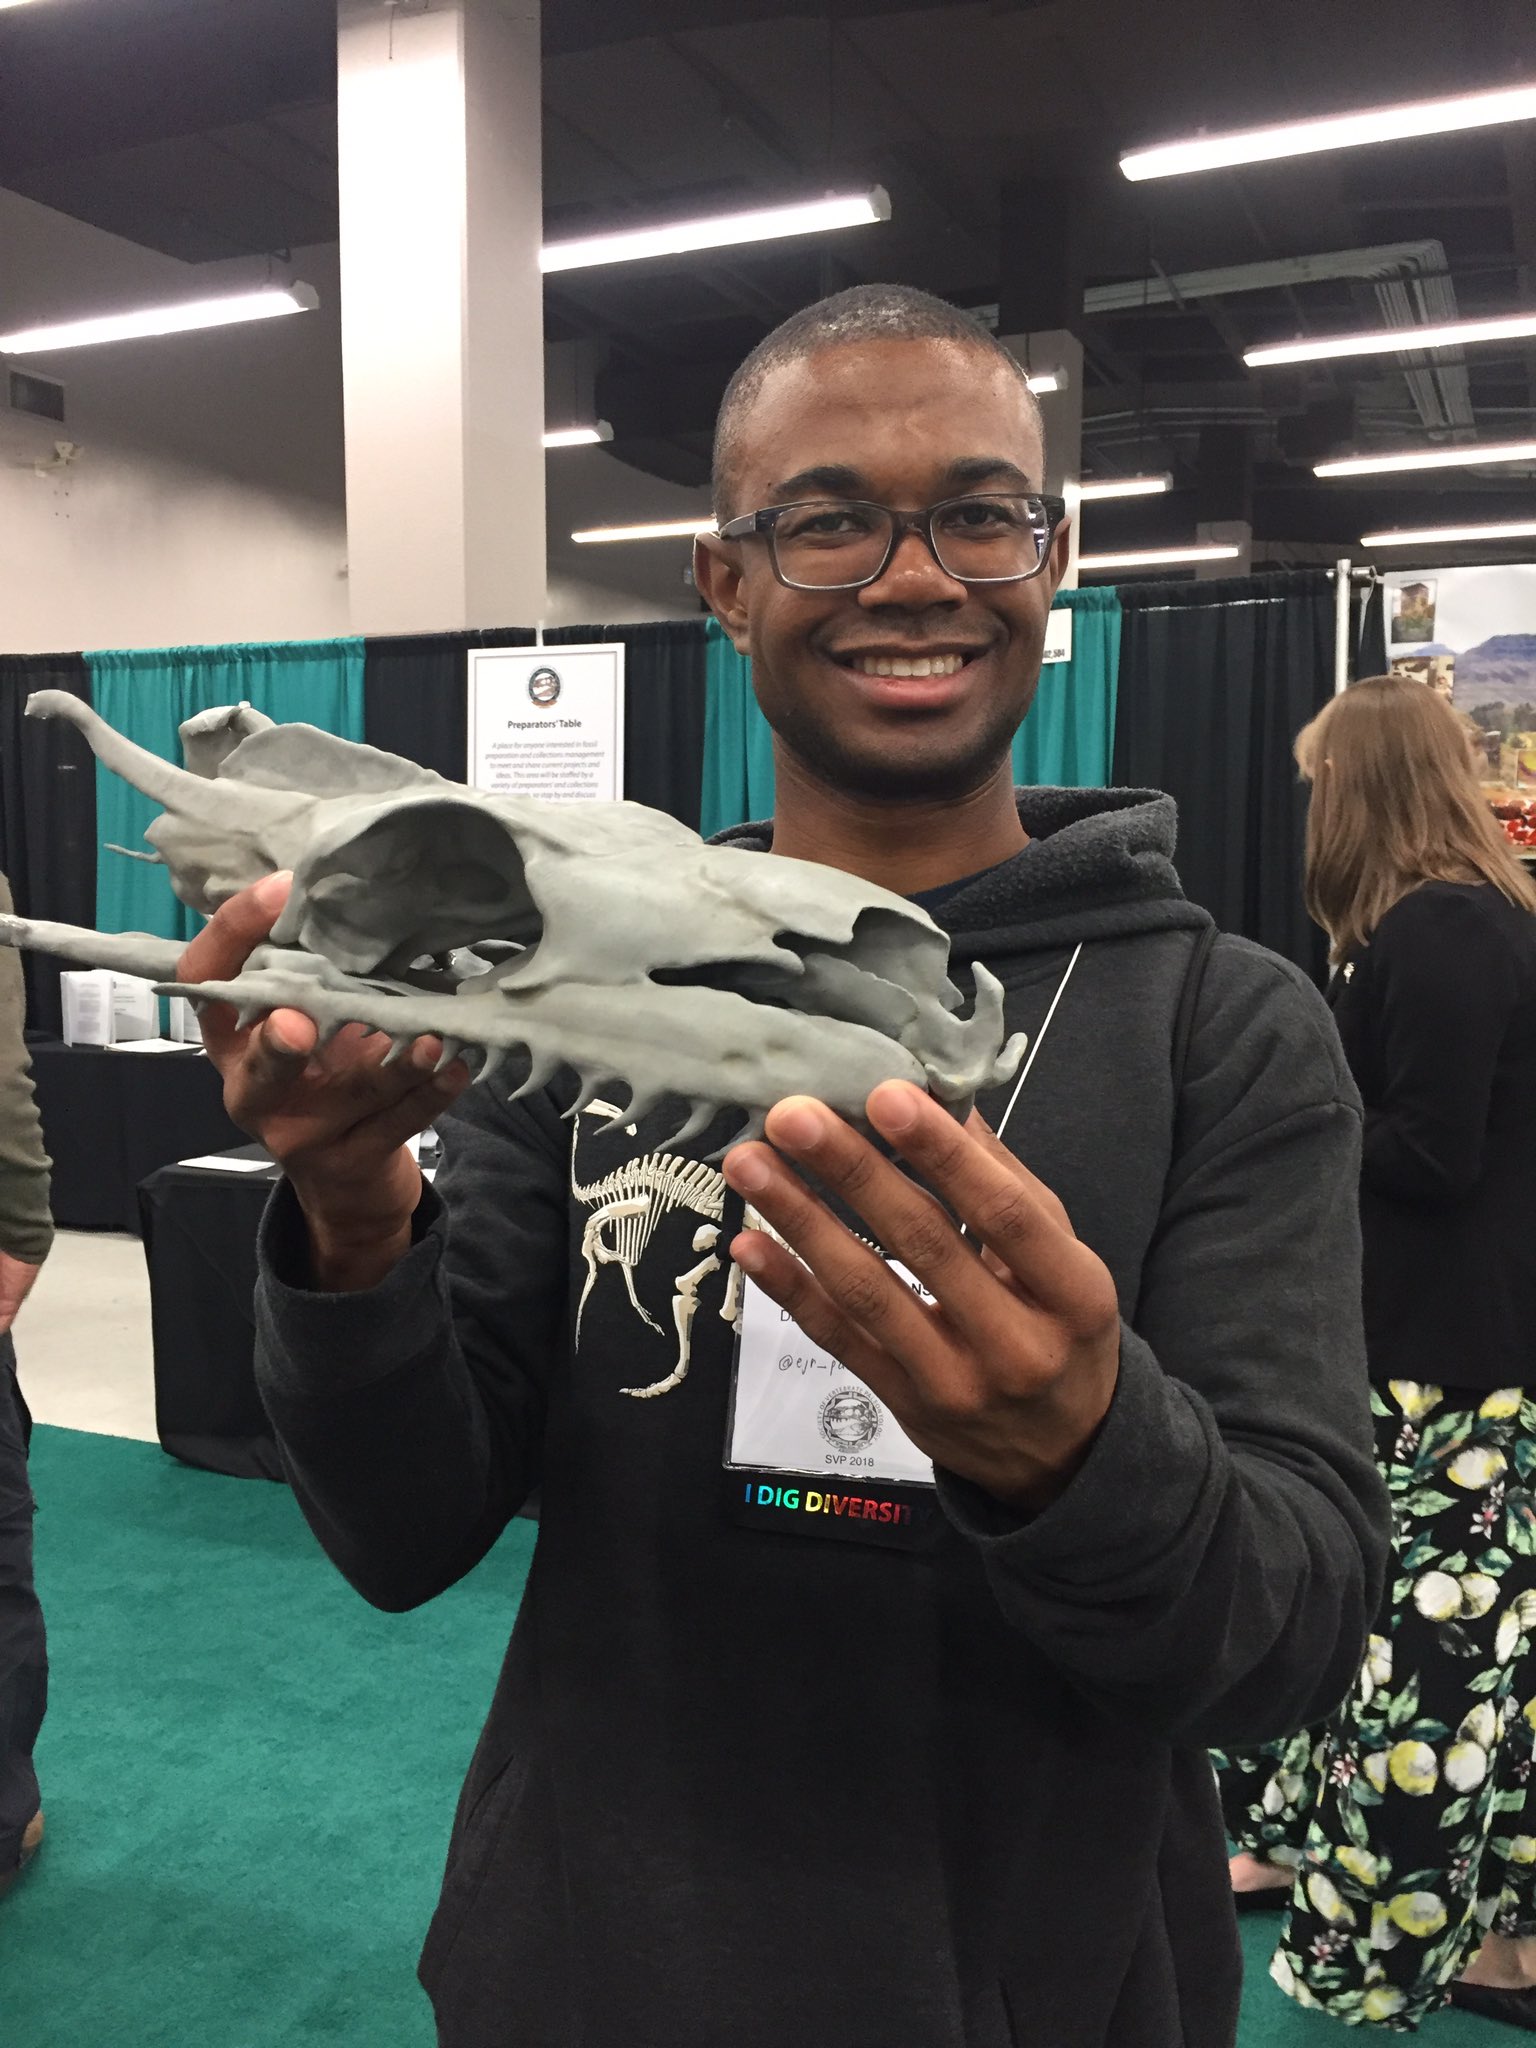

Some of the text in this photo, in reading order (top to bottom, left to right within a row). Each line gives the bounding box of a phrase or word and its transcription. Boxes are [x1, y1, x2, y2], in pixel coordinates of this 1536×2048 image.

[559, 719, 582, 728] Table
[565, 751, 605, 759] management
[825, 1454, 875, 1467] SVP 2018
[745, 1483, 914, 1526] I DIG DIVERSIT
